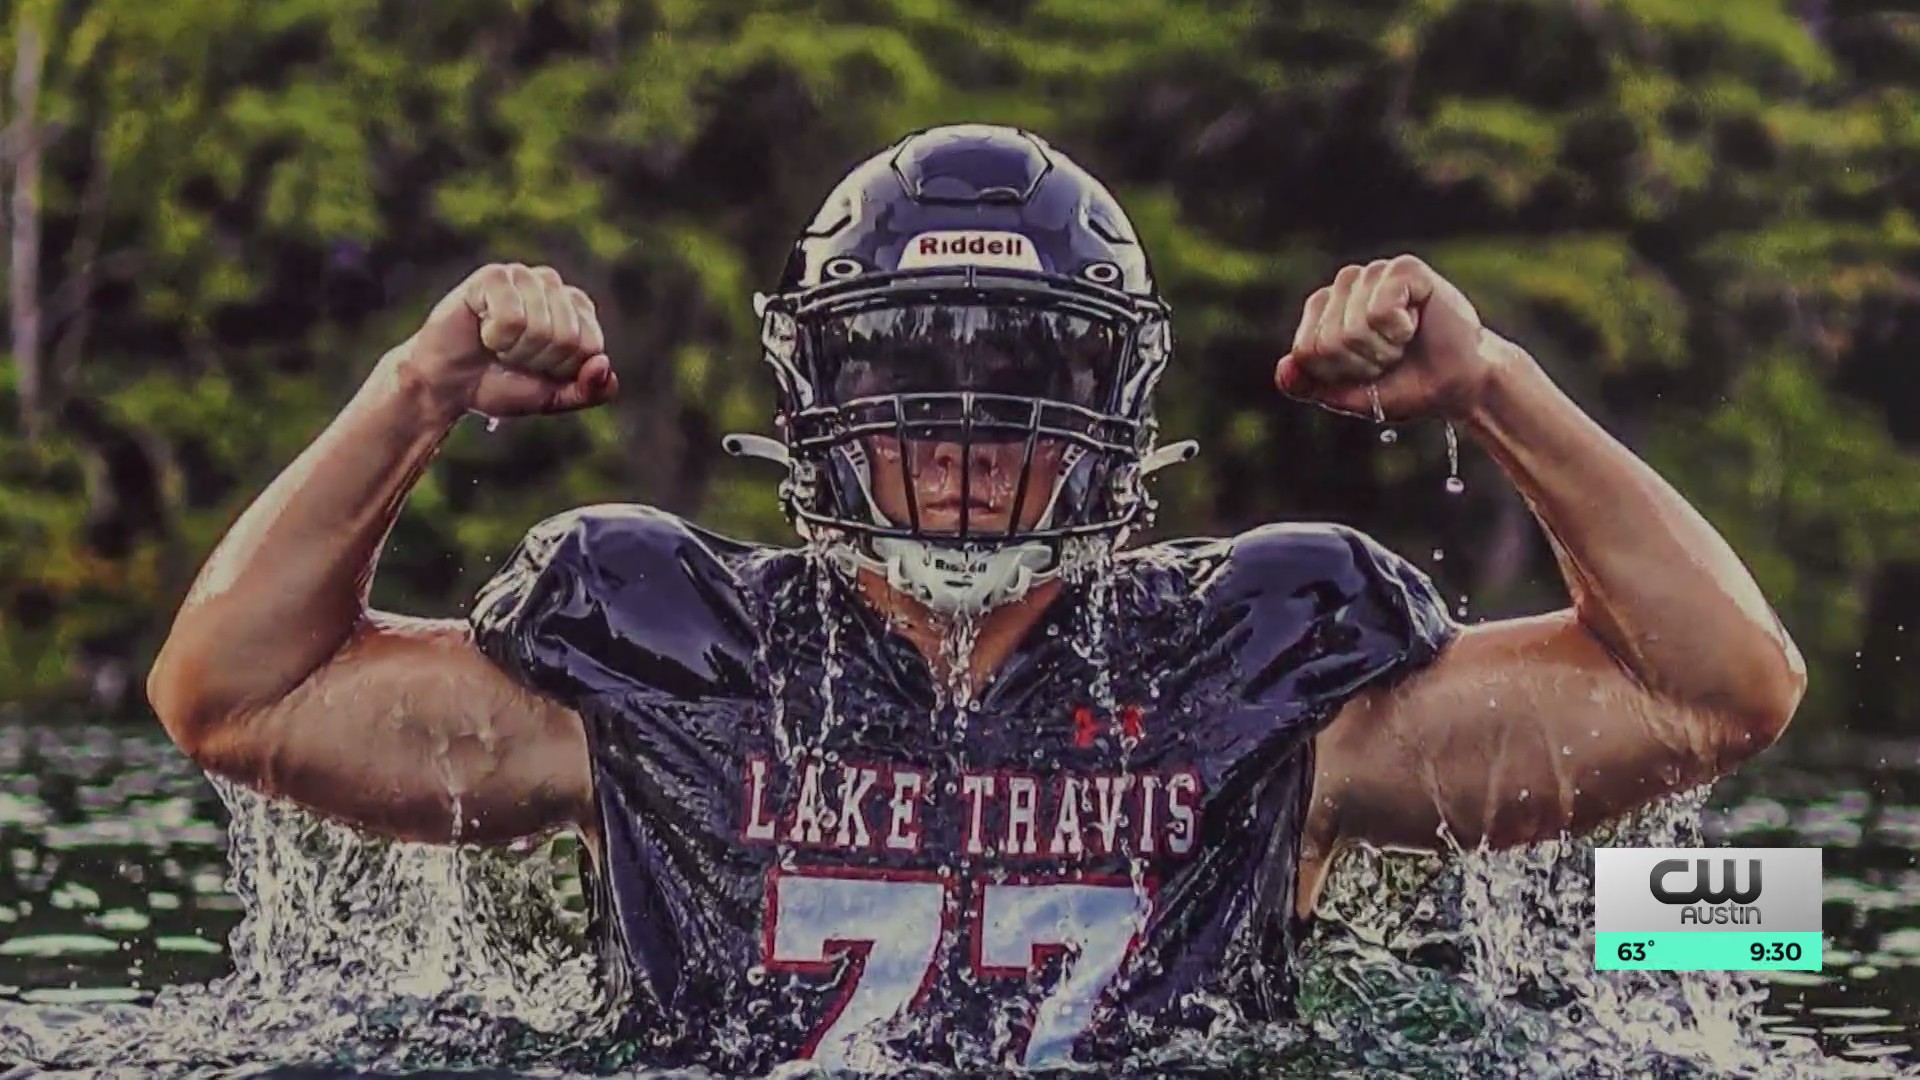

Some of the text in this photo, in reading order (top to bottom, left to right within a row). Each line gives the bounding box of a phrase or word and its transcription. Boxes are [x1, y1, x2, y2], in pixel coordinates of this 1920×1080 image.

[919, 236, 1022, 256] Riddell
[743, 755, 1199, 855] LAKE TRAVIS
[763, 866, 1158, 1074] 77
